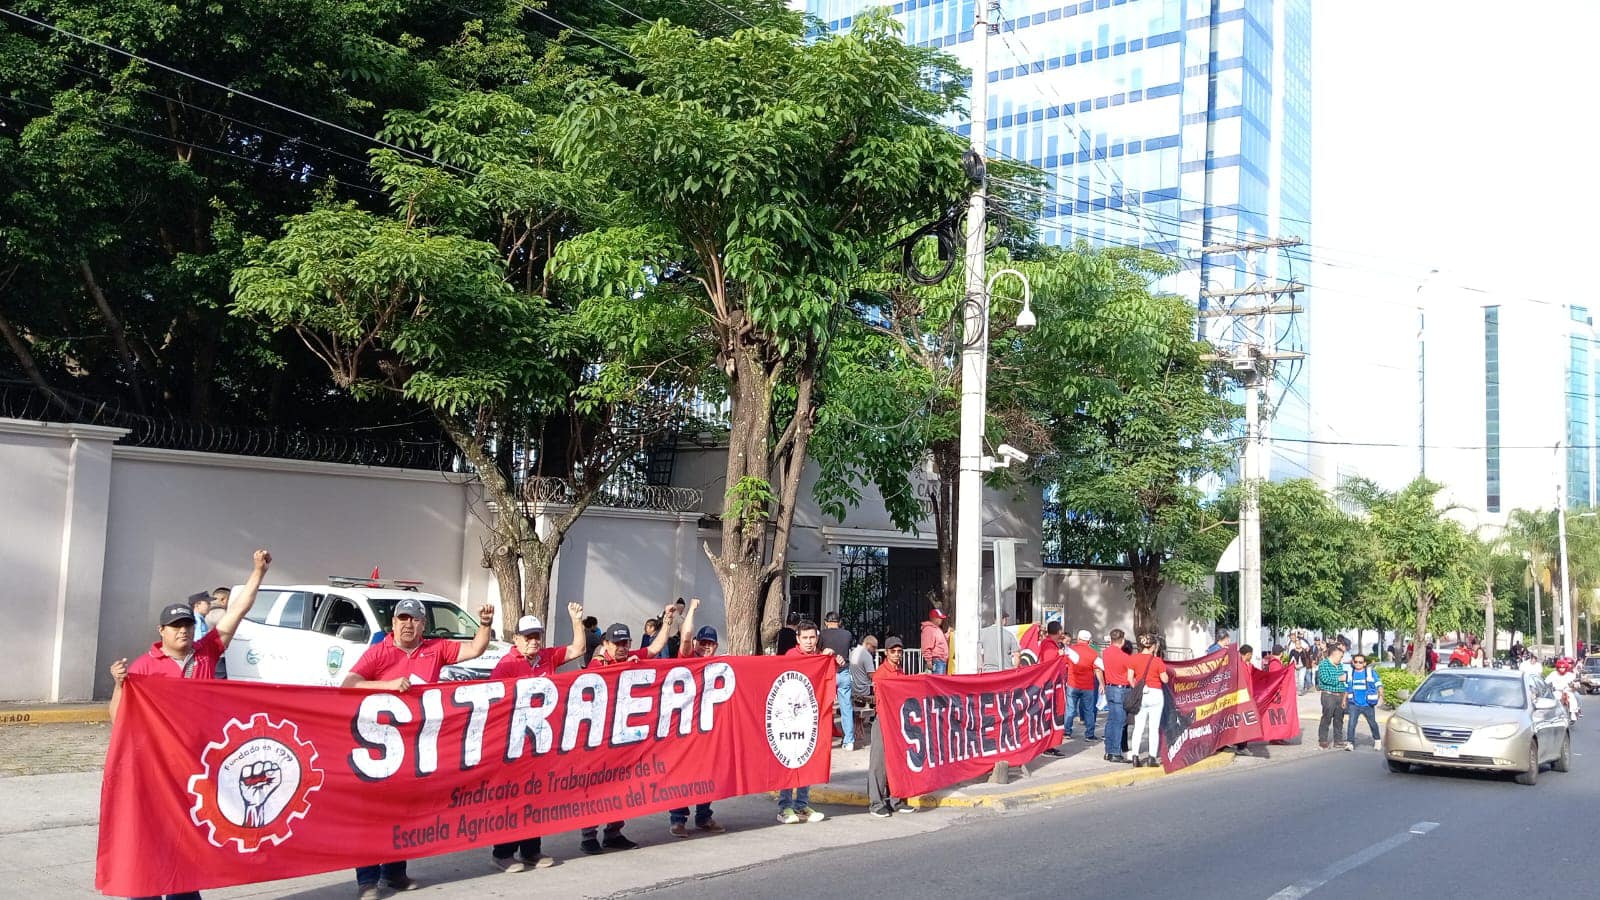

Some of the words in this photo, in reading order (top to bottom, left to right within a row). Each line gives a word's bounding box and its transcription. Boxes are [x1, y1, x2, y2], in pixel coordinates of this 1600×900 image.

[349, 662, 736, 781] SITRAEAP
[779, 731, 805, 741] FUTH
[447, 779, 519, 808] Sindicato
[524, 772, 542, 795] de
[548, 761, 632, 792] Trabajadores
[634, 757, 650, 778] de
[652, 753, 666, 774] la
[392, 815, 450, 850] Escuela
[523, 794, 622, 827] Panamericana
[625, 782, 647, 808] del
[649, 780, 715, 803] Zamorano
